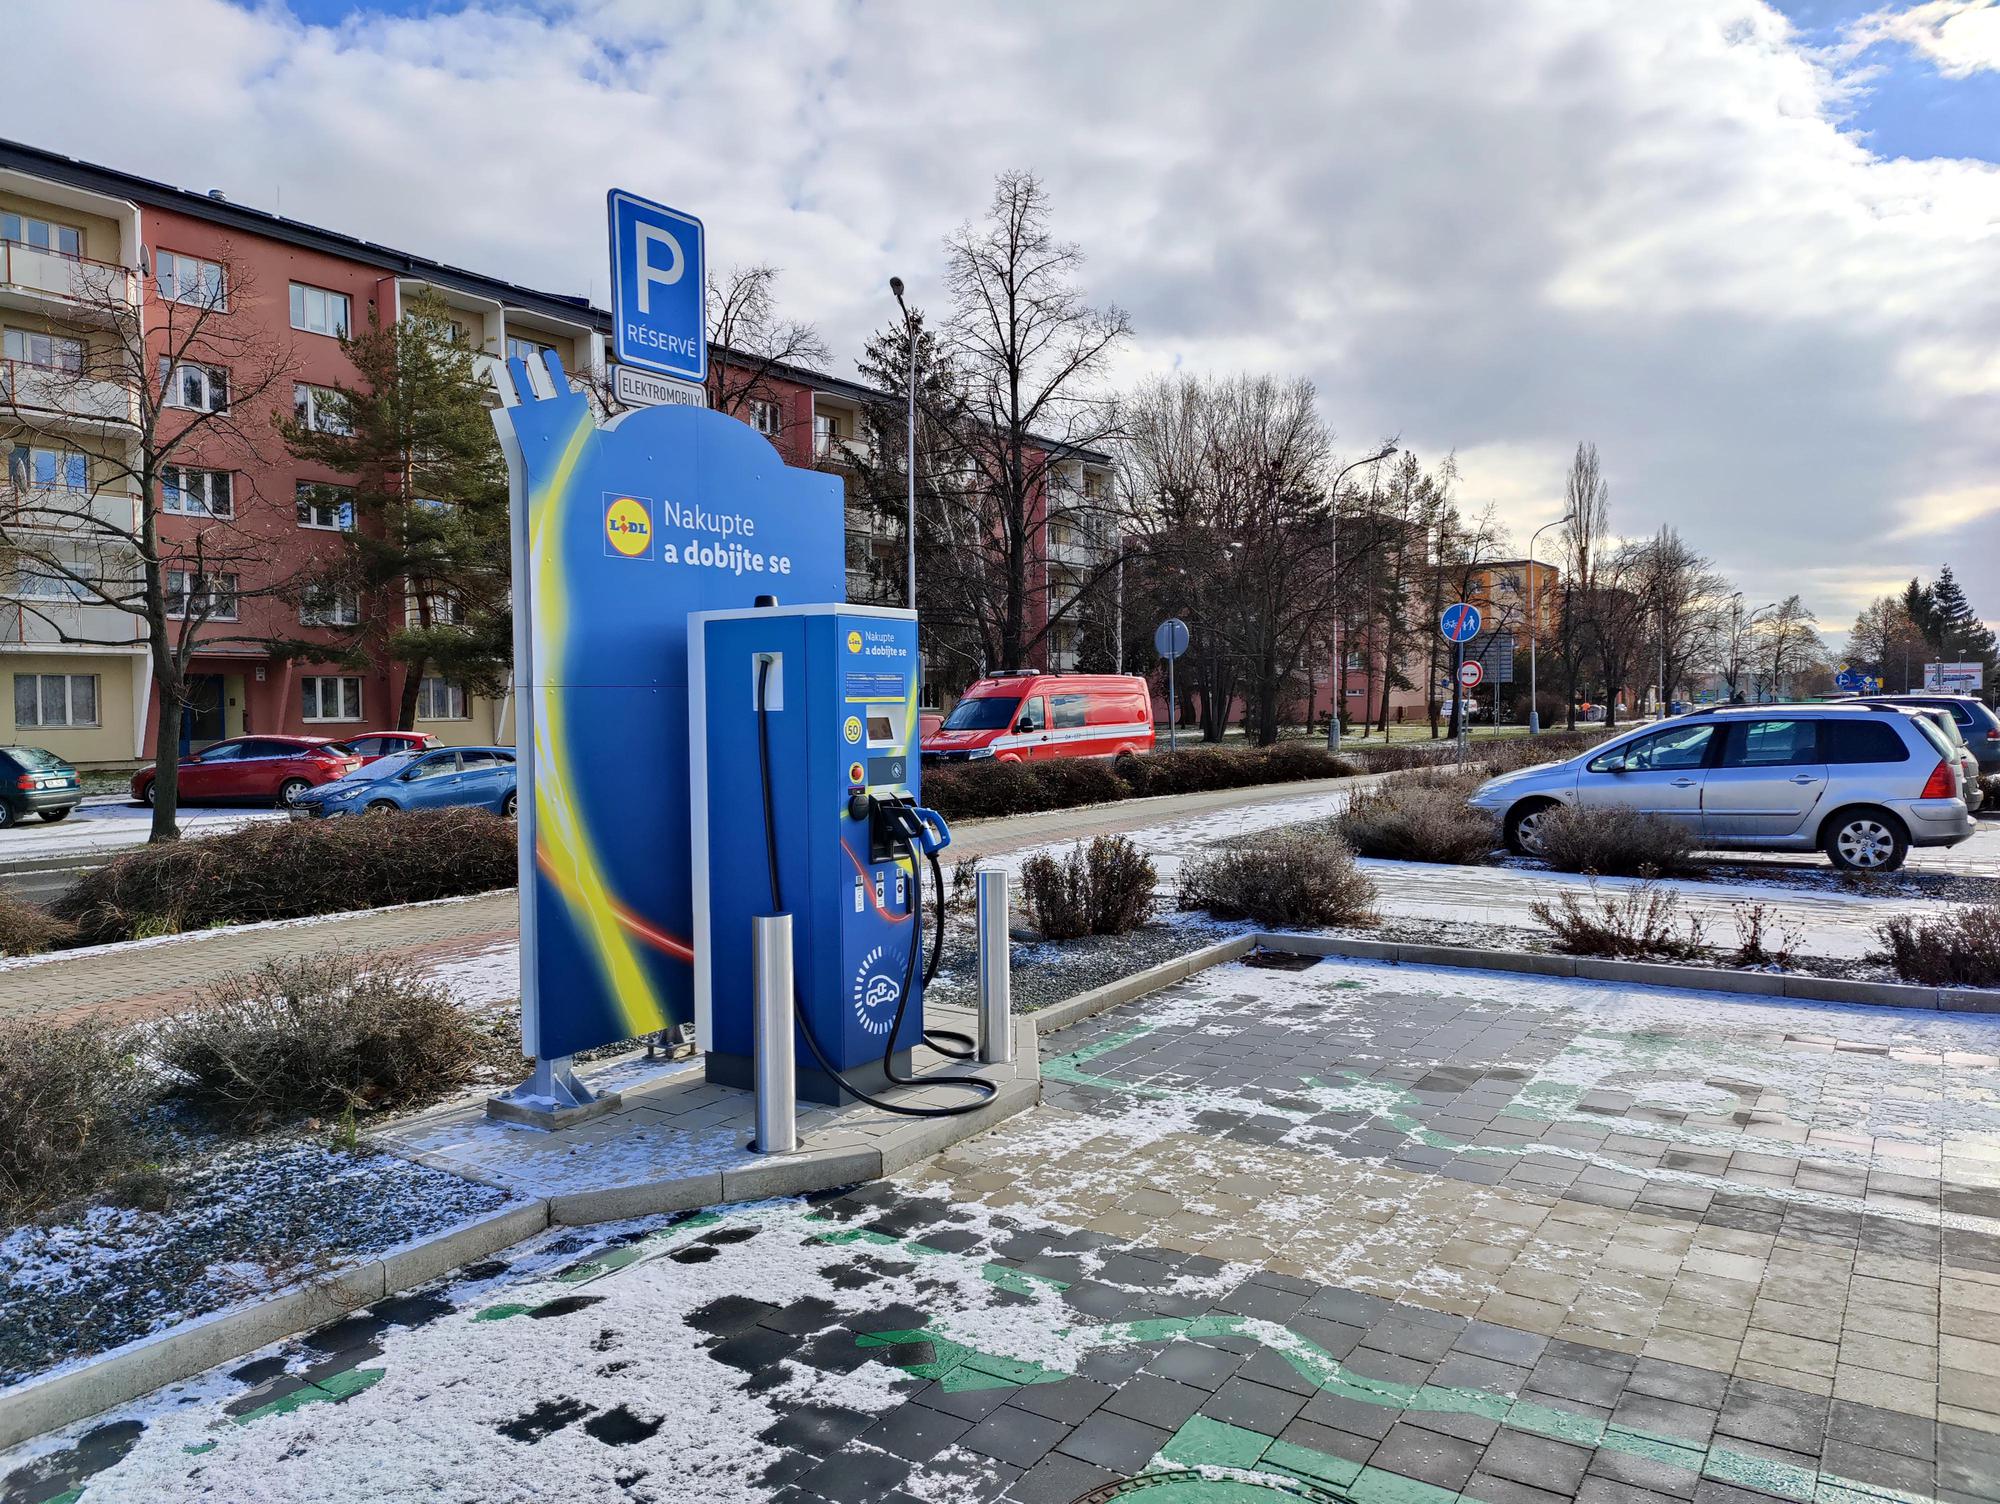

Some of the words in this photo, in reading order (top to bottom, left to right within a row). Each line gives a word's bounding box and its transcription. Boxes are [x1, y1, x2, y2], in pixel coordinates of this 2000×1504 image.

[634, 220, 685, 315] P
[627, 323, 697, 358] RÉSERVÉ
[664, 500, 754, 540] Nakupte
[664, 543, 679, 564] a
[684, 539, 764, 576] dobijte
[769, 555, 791, 575] se
[865, 631, 895, 643] Nakupte
[865, 647, 871, 655] a
[871, 645, 898, 658] dobijte
[898, 648, 907, 656] se
[848, 725, 859, 736] 50
